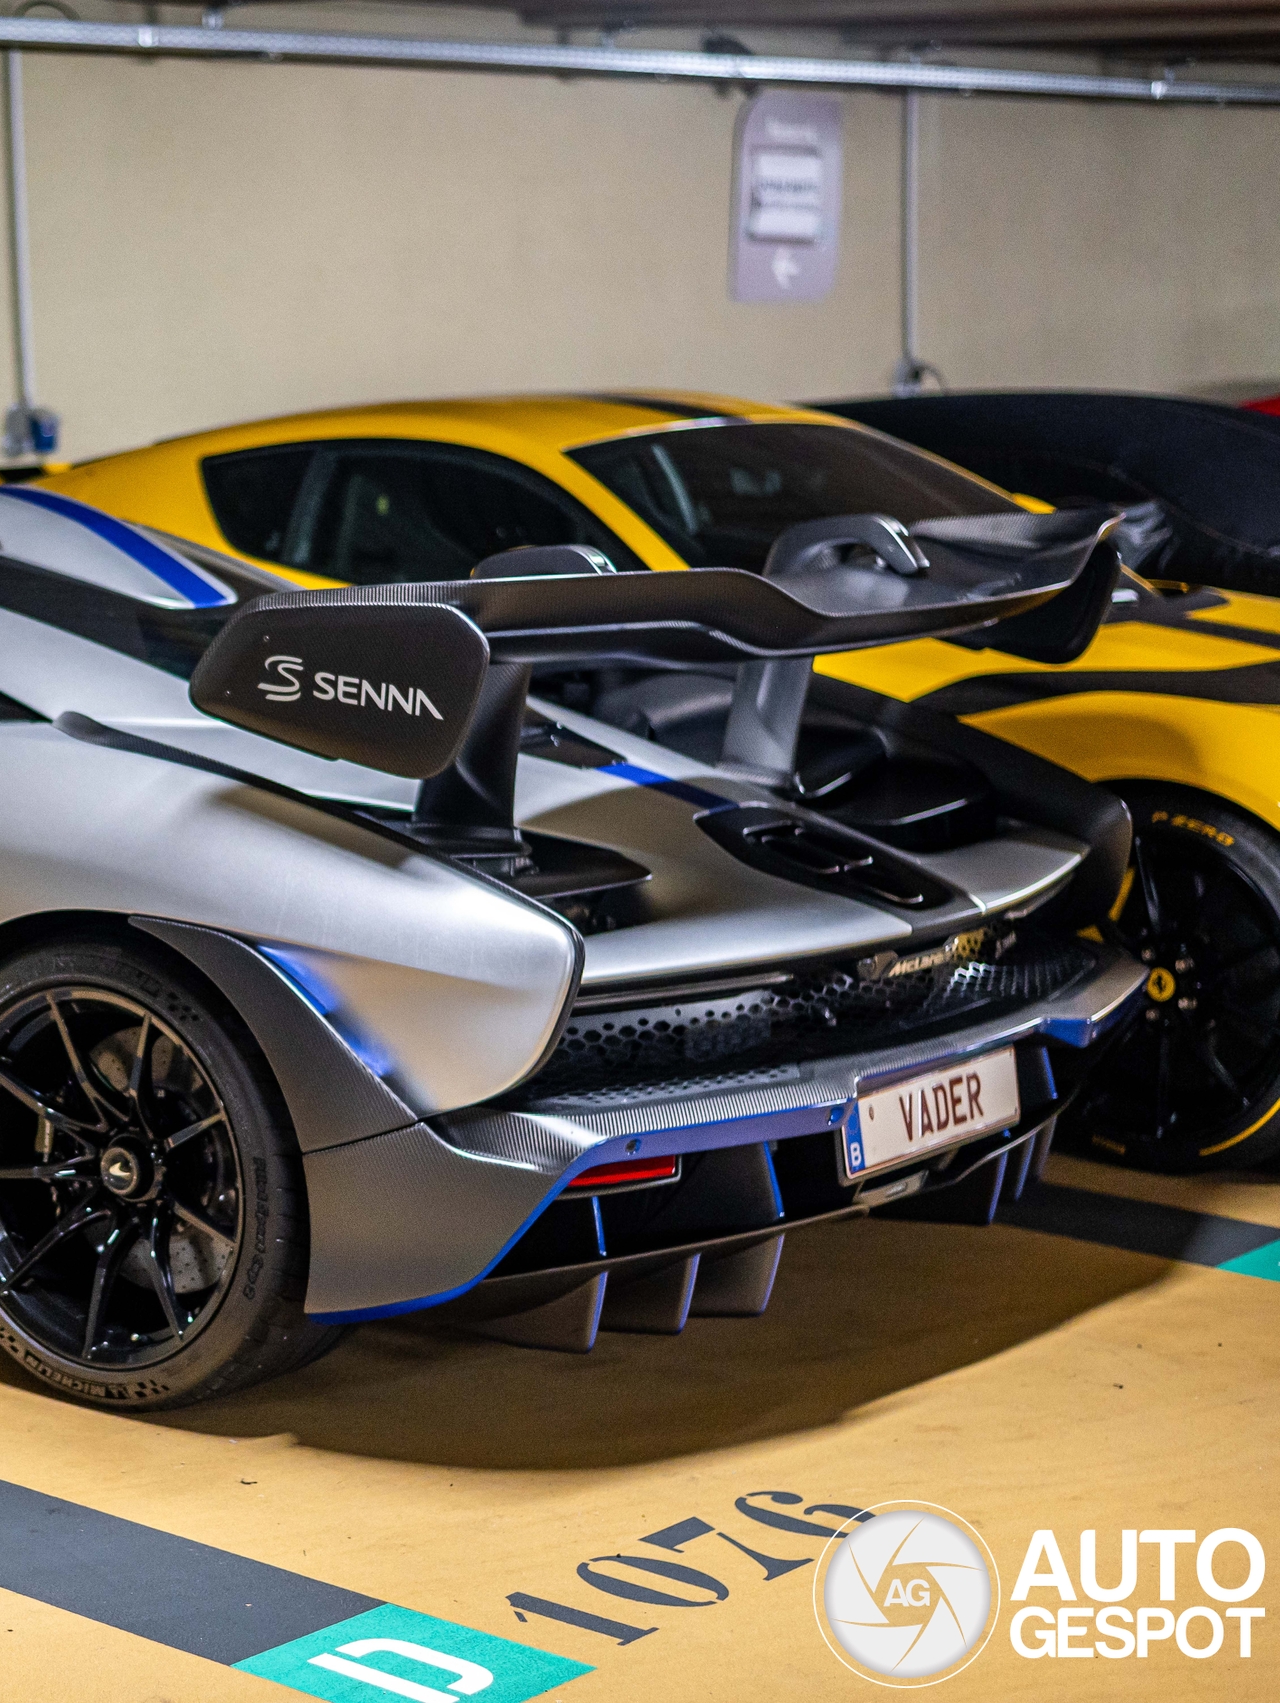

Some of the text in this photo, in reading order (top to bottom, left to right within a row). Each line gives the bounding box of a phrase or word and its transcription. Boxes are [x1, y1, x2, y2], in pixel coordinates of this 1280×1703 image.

[313, 672, 445, 721] SENNA
[899, 1071, 984, 1142] VADER
[850, 1142, 862, 1166] B
[505, 1491, 876, 1646] 1076
